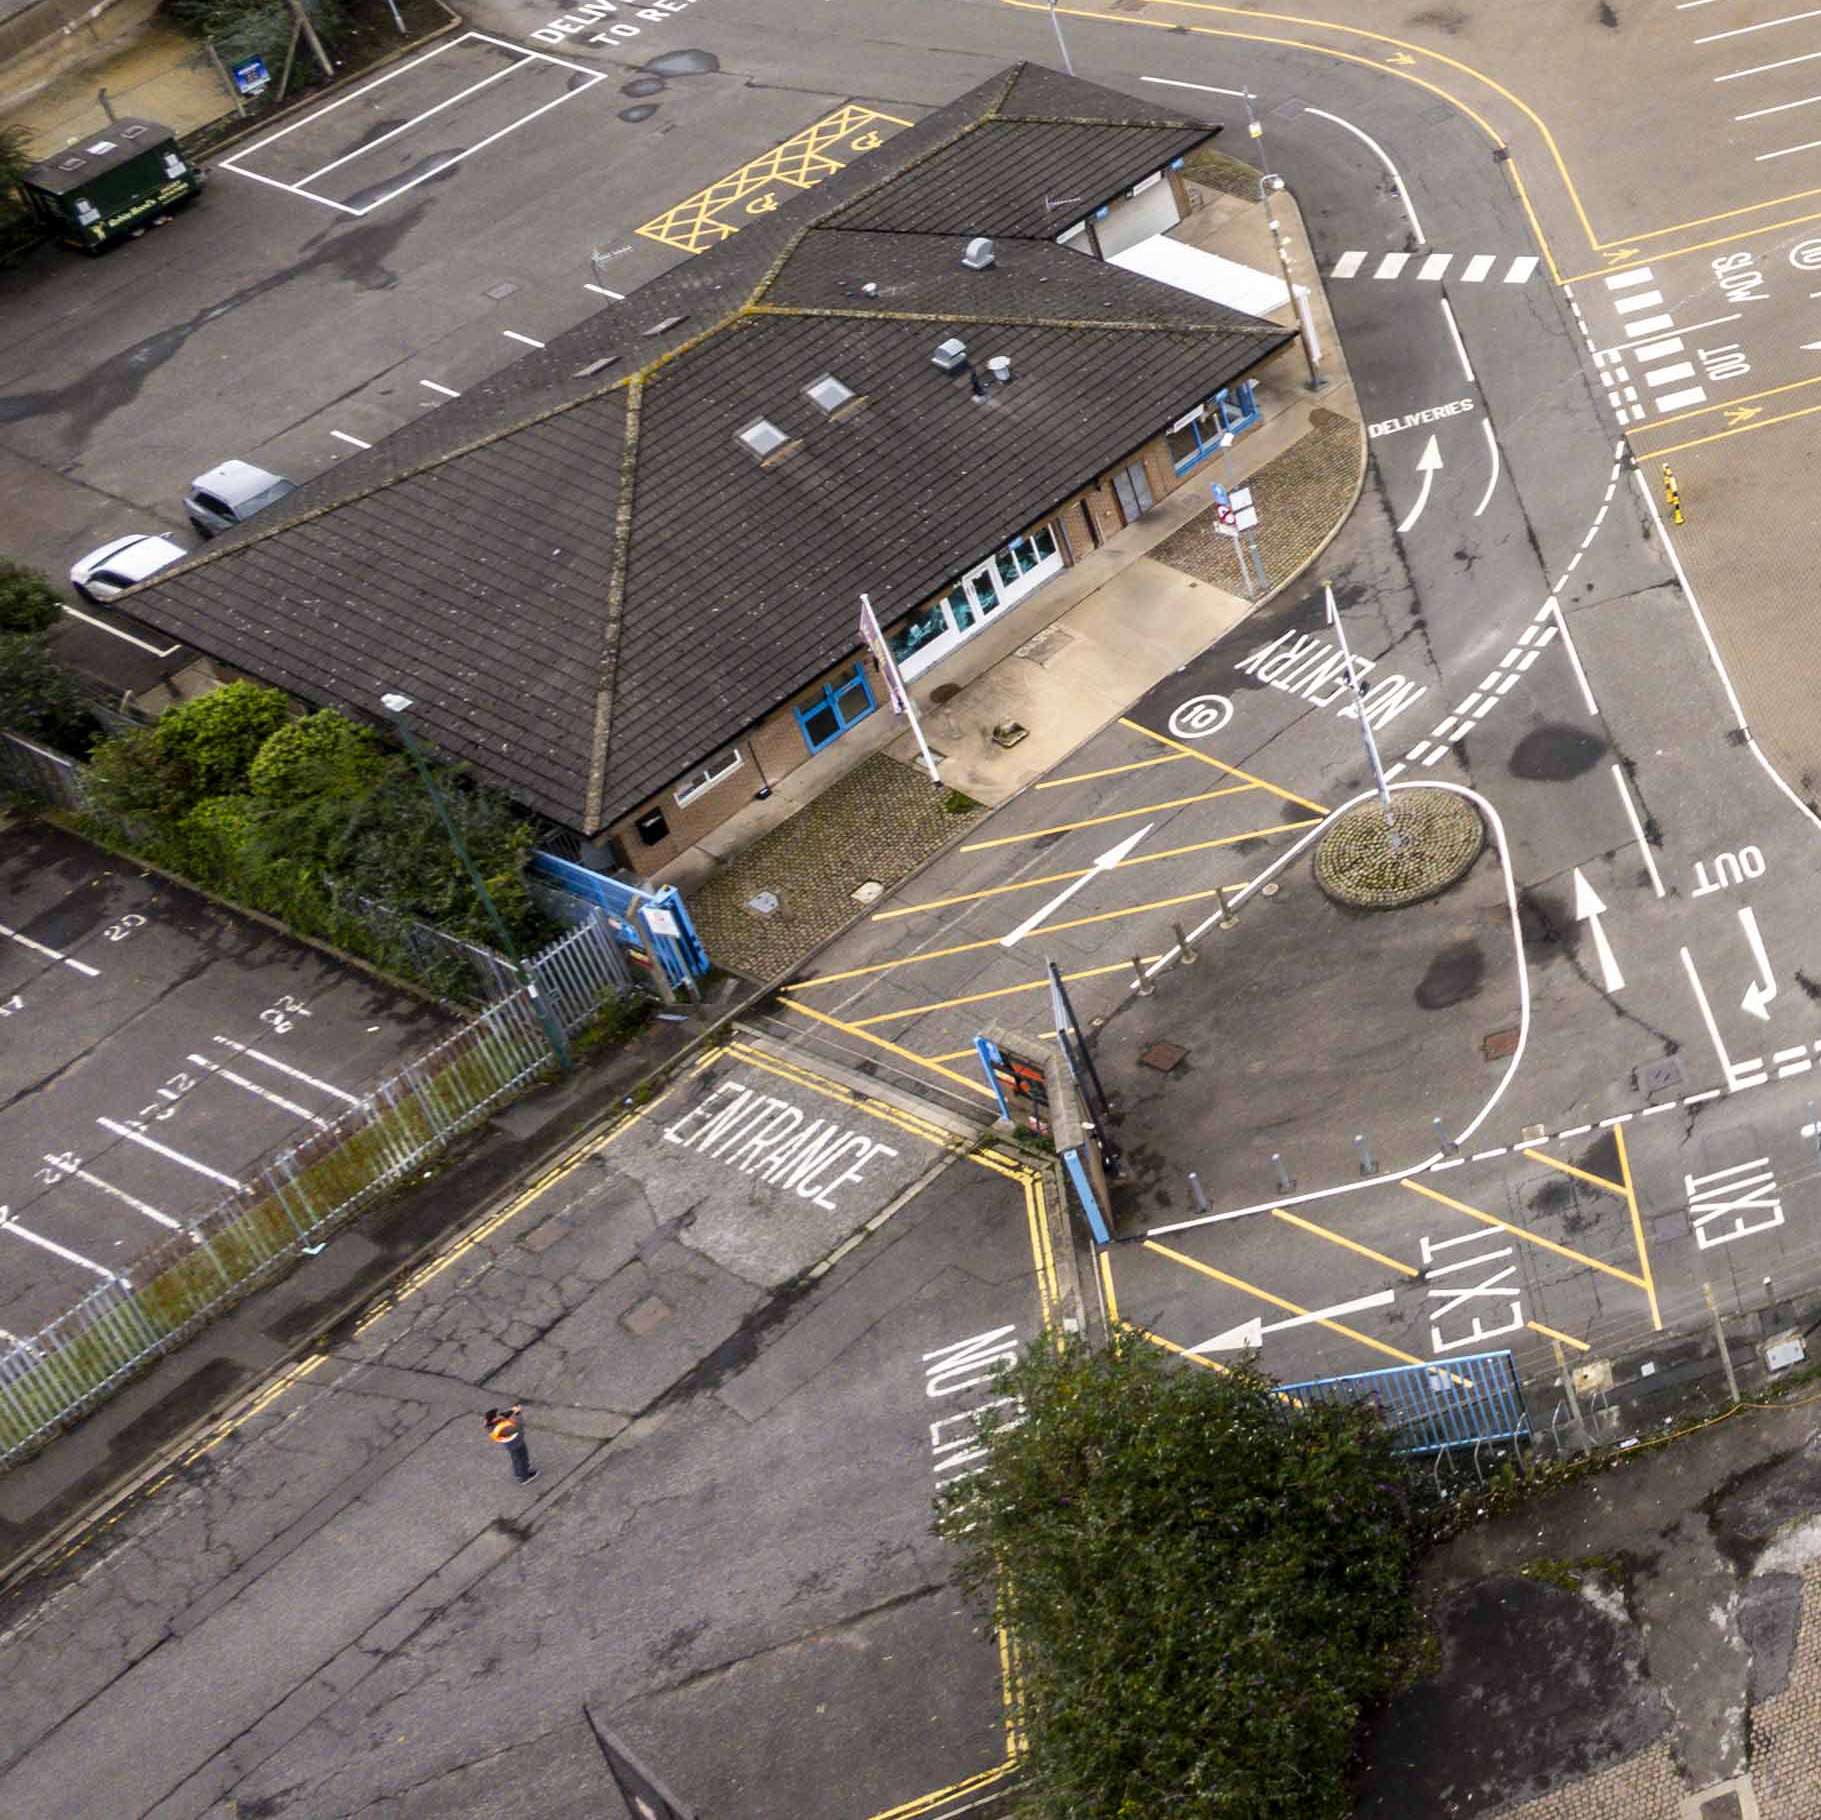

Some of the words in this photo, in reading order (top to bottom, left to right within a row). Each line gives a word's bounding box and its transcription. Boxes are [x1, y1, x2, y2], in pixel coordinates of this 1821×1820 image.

[590, 23, 640, 47] TO
[1711, 252, 1770, 304] SLOW
[1698, 344, 1752, 382] OUT
[1368, 398, 1474, 439] DELIVERIES
[1234, 628, 1377, 708] ENTRY
[1338, 674, 1428, 732] NO
[1691, 845, 1766, 898] OUT
[663, 1080, 900, 1211] ENTRANCE
[1683, 1156, 1785, 1251] EXIT
[1418, 1223, 1524, 1354] EXIT
